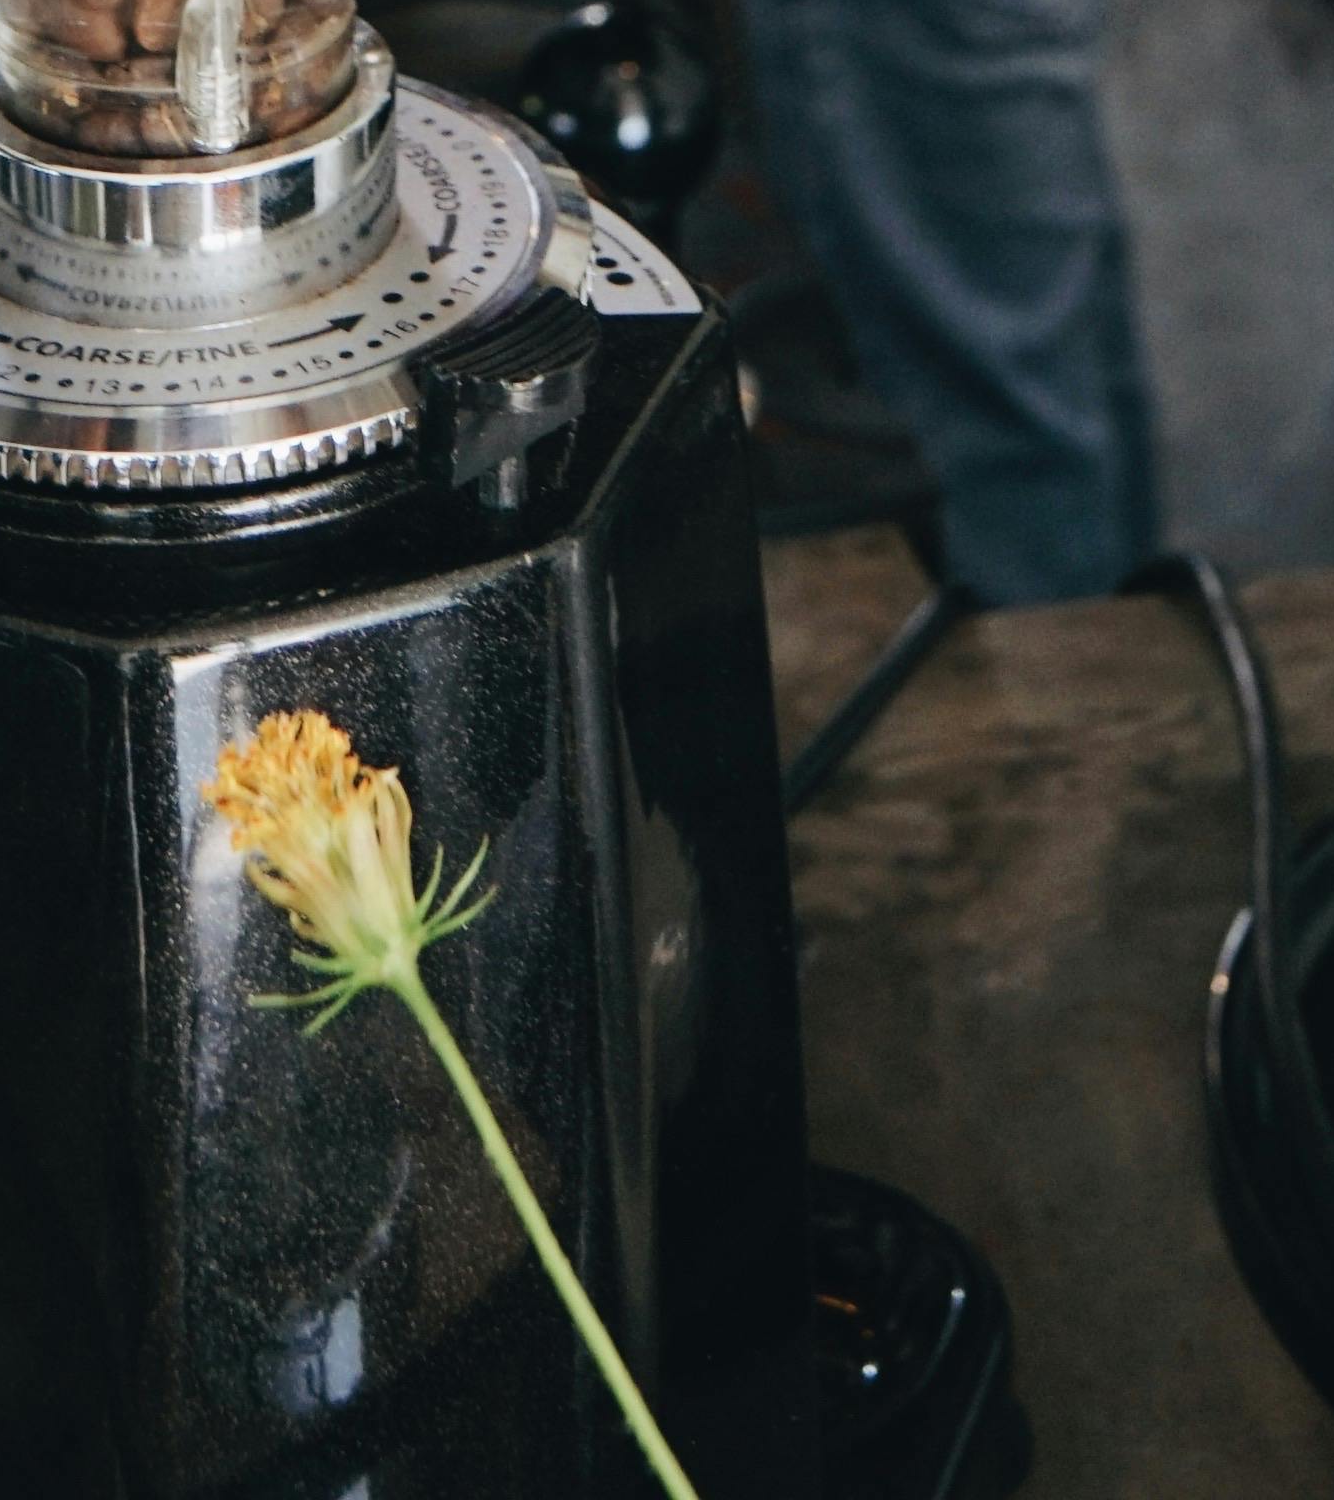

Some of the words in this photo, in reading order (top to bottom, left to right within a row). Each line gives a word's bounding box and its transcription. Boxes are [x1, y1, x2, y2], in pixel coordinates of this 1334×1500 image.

[483, 228, 511, 247] 18
[449, 275, 483, 296] 17
[381, 319, 419, 342] 16
[14, 336, 260, 367] COARSE/FINE
[294, 355, 333, 375] 15
[86, 378, 121, 395] 13
[192, 375, 225, 392] 14
